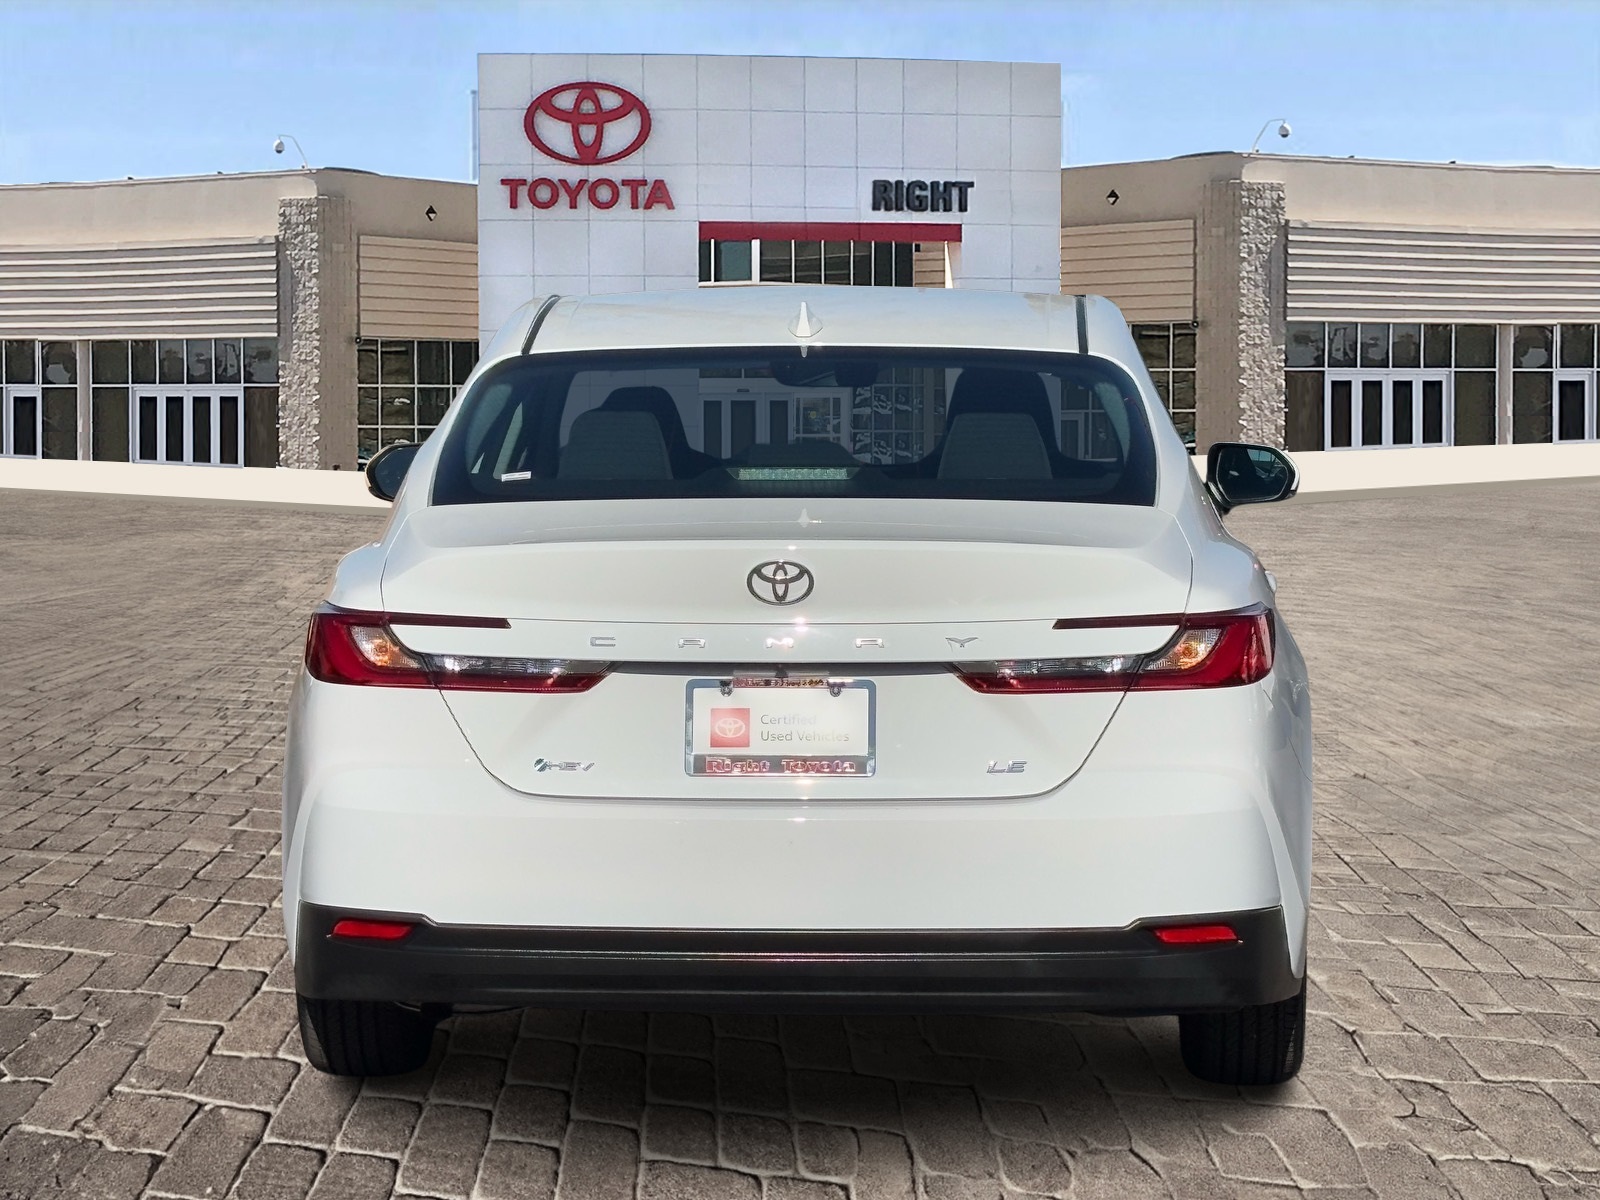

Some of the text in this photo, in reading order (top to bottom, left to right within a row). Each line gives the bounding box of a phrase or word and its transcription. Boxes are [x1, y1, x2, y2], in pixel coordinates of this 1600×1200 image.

[500, 178, 675, 210] TOYOTA
[872, 179, 975, 212] RIGHT
[590, 636, 979, 648] CAMRY
[760, 714, 817, 726] Certified
[760, 730, 850, 742] Used Vehicles
[705, 756, 857, 774] Right Toyota
[986, 760, 1028, 774] LE
